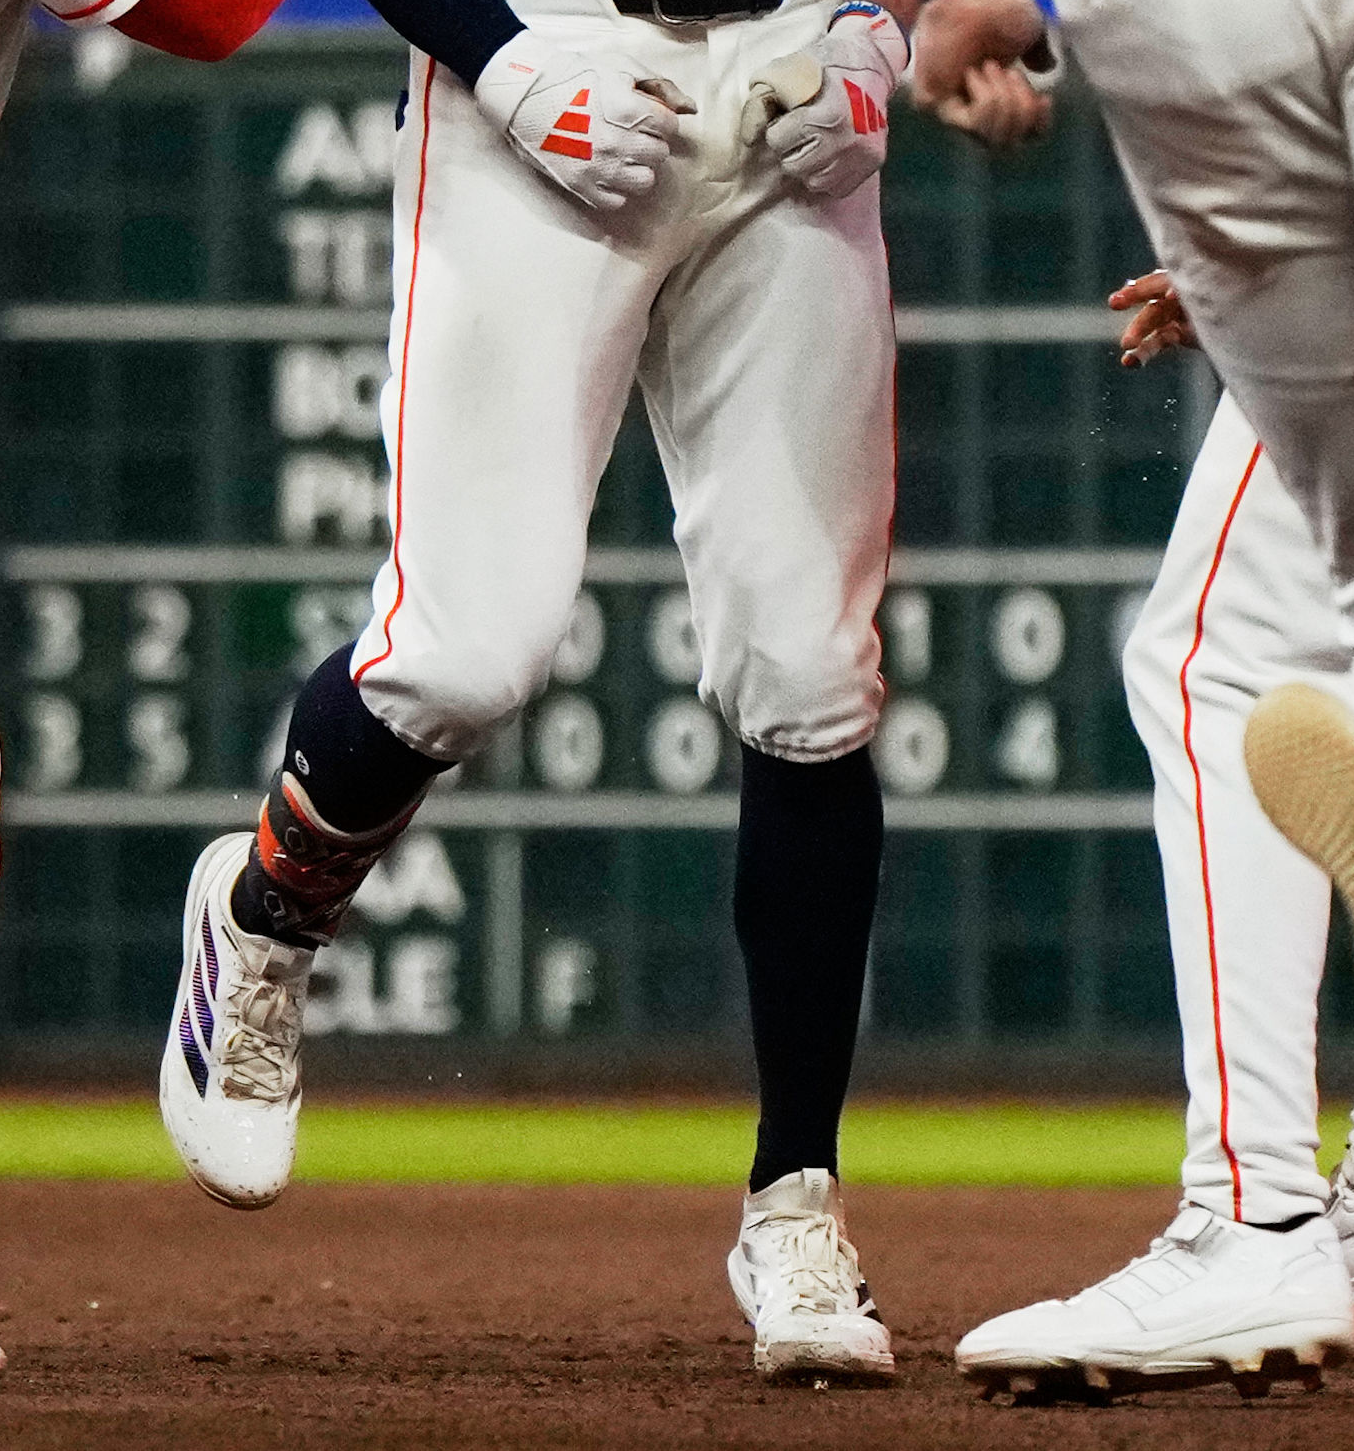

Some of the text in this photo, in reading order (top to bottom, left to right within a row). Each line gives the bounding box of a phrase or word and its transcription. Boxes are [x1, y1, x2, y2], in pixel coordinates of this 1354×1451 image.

[273, 348, 385, 440] BO
[993, 585, 1064, 684] 0
[537, 694, 604, 793] 0
[649, 694, 721, 793] 0
[879, 696, 949, 795] 0
[999, 696, 1060, 791] 4
